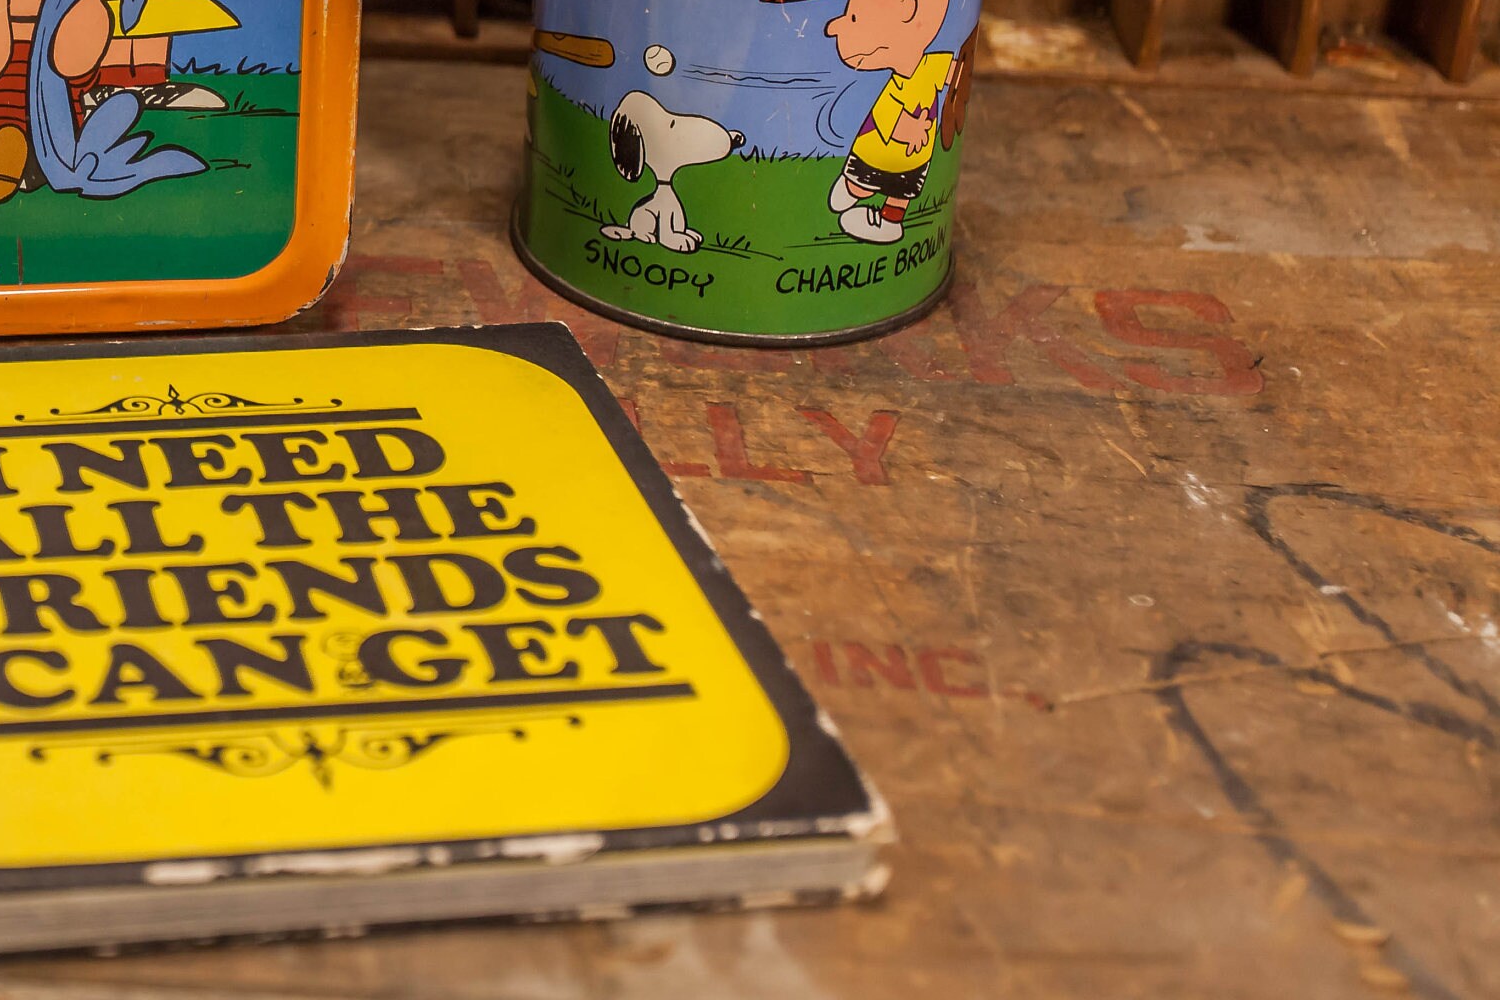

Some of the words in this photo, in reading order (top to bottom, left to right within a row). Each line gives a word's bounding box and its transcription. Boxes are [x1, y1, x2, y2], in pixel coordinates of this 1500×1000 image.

[584, 240, 714, 298] SNOOPY
[775, 257, 886, 294] CHARLIE
[894, 224, 947, 277] BROWN
[41, 427, 446, 492] NEED
[221, 482, 536, 547] THE
[358, 615, 664, 687] GET
